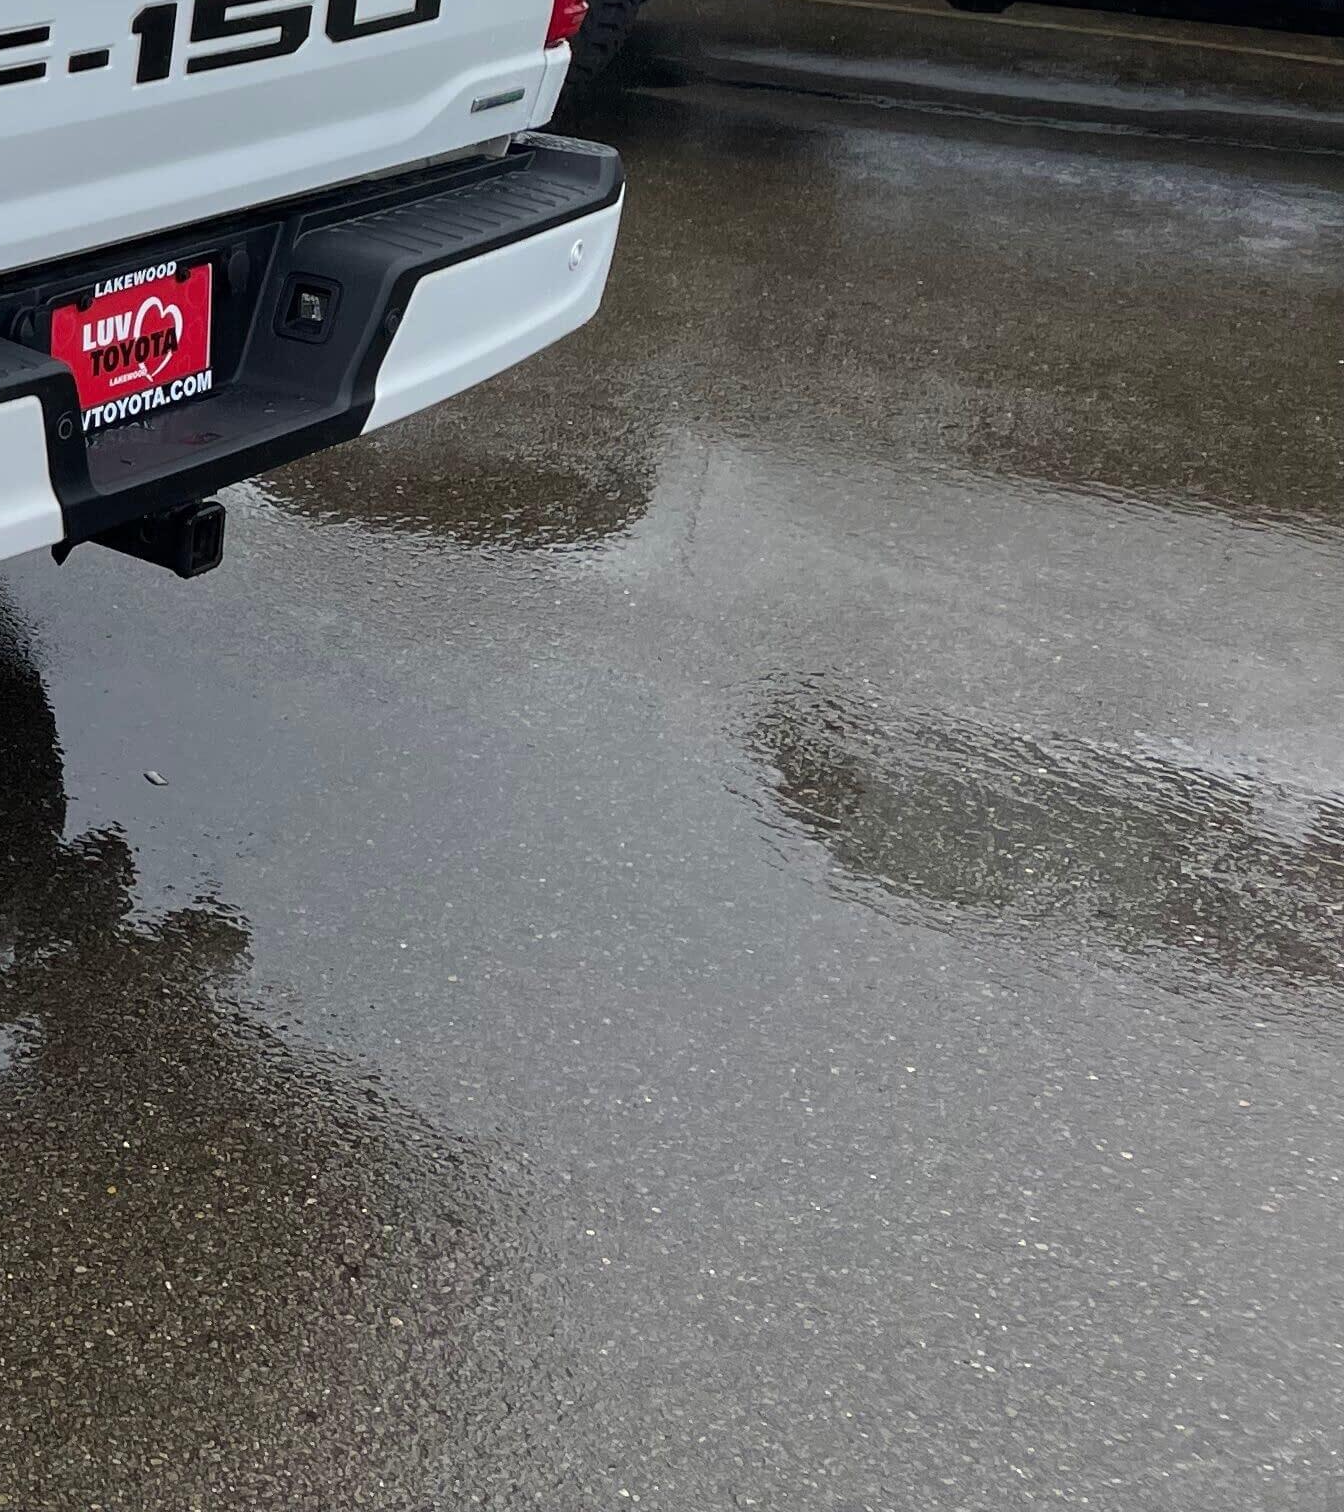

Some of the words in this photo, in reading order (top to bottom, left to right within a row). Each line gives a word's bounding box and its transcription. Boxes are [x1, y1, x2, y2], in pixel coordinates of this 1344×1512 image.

[94, 261, 177, 298] LAKEWOOD
[83, 311, 132, 351] LUV
[90, 328, 178, 377] TOYOTA
